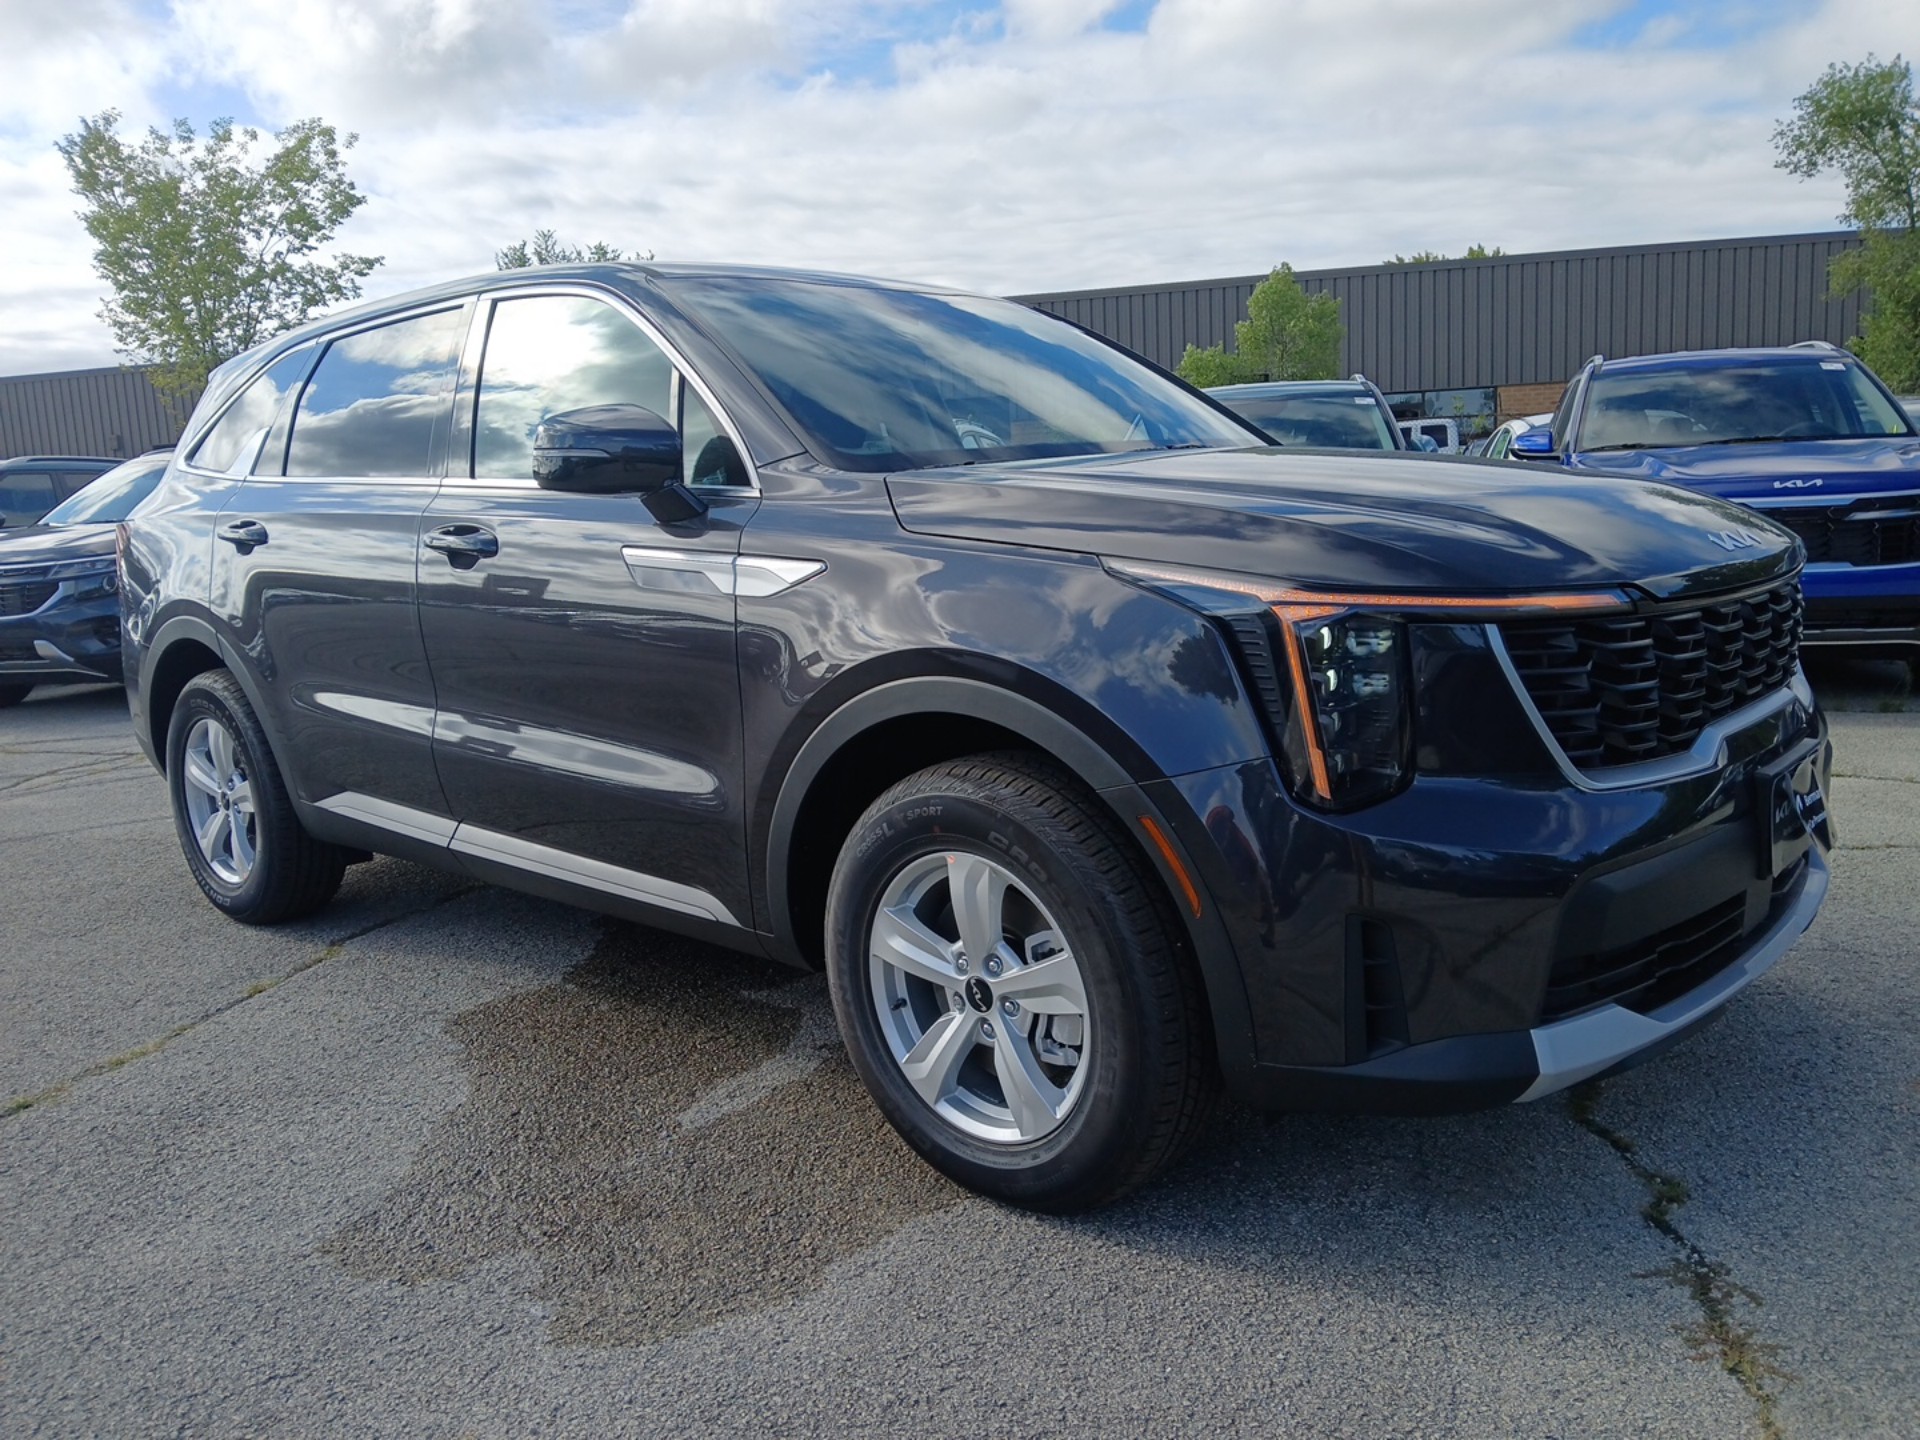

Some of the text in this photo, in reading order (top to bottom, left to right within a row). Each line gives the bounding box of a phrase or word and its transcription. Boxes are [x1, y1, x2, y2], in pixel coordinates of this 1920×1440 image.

[1773, 478, 1823, 489] KIA
[1707, 530, 1761, 552] KIA
[906, 806, 944, 821] SPORT
